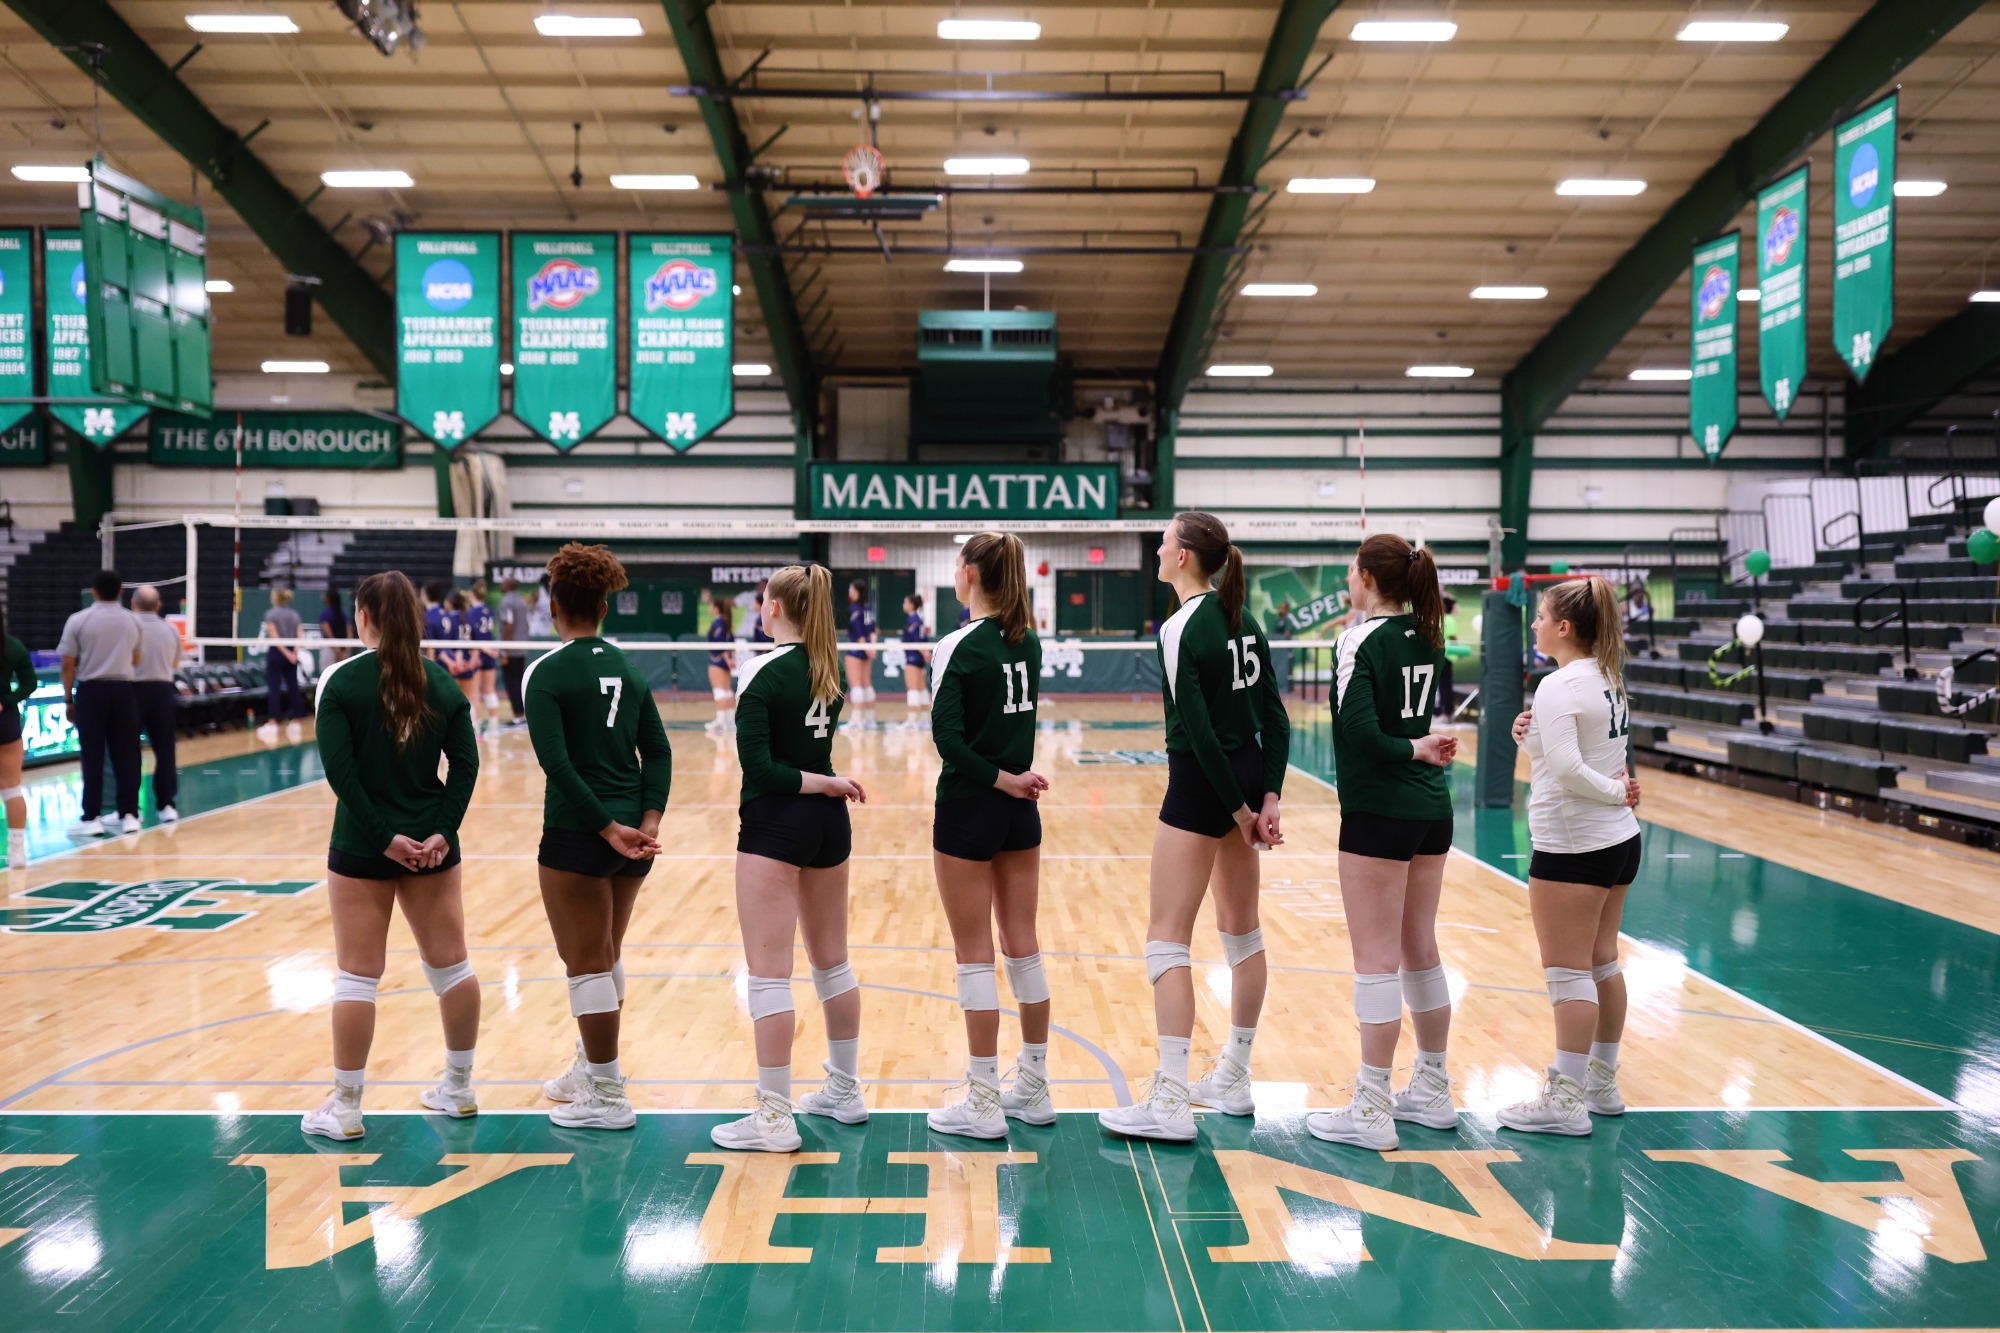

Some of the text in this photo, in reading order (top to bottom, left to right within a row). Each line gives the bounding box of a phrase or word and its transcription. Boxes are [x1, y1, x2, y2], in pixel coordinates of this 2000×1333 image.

[528, 267, 600, 311] MAAC
[645, 267, 717, 311] MAAC
[402, 316, 494, 331] TOURNAMENT
[519, 317, 608, 332] TOURNAMENT
[403, 331, 494, 347] APPEARANCES
[521, 332, 608, 349] CHAMPIONS
[638, 331, 725, 348] CHAMPIONS
[84, 408, 116, 437] M
[433, 411, 465, 440] M
[548, 411, 580, 440] M
[665, 412, 697, 440] M
[159, 428, 391, 454] THE 6TH BOROUGH
[822, 473, 1107, 510] MANHATTAN
[1227, 635, 1261, 691] 15
[1002, 660, 1034, 714] 11
[1402, 664, 1434, 719] 17
[598, 676, 623, 728] 7
[805, 697, 831, 739] 4
